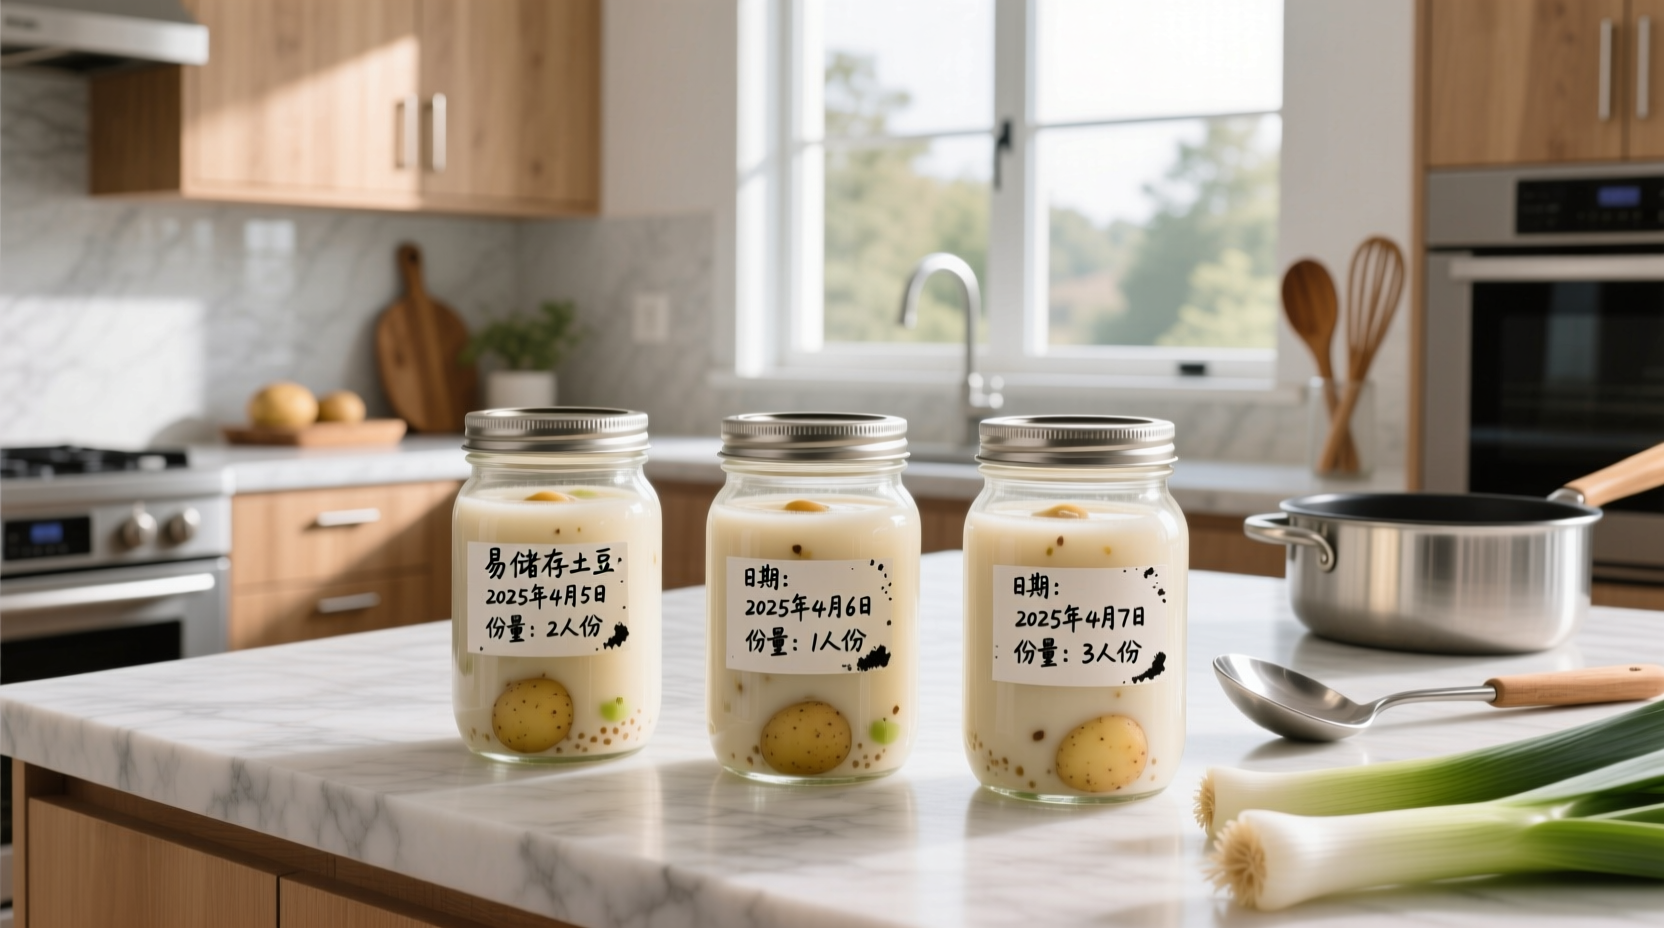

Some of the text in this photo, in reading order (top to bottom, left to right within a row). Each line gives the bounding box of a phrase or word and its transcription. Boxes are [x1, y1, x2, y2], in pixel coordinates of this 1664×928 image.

[485, 583, 606, 610] 2025年4月5日
[745, 593, 871, 622] 2025年4月6日
[1015, 604, 1145, 633] 2025年4月7日
